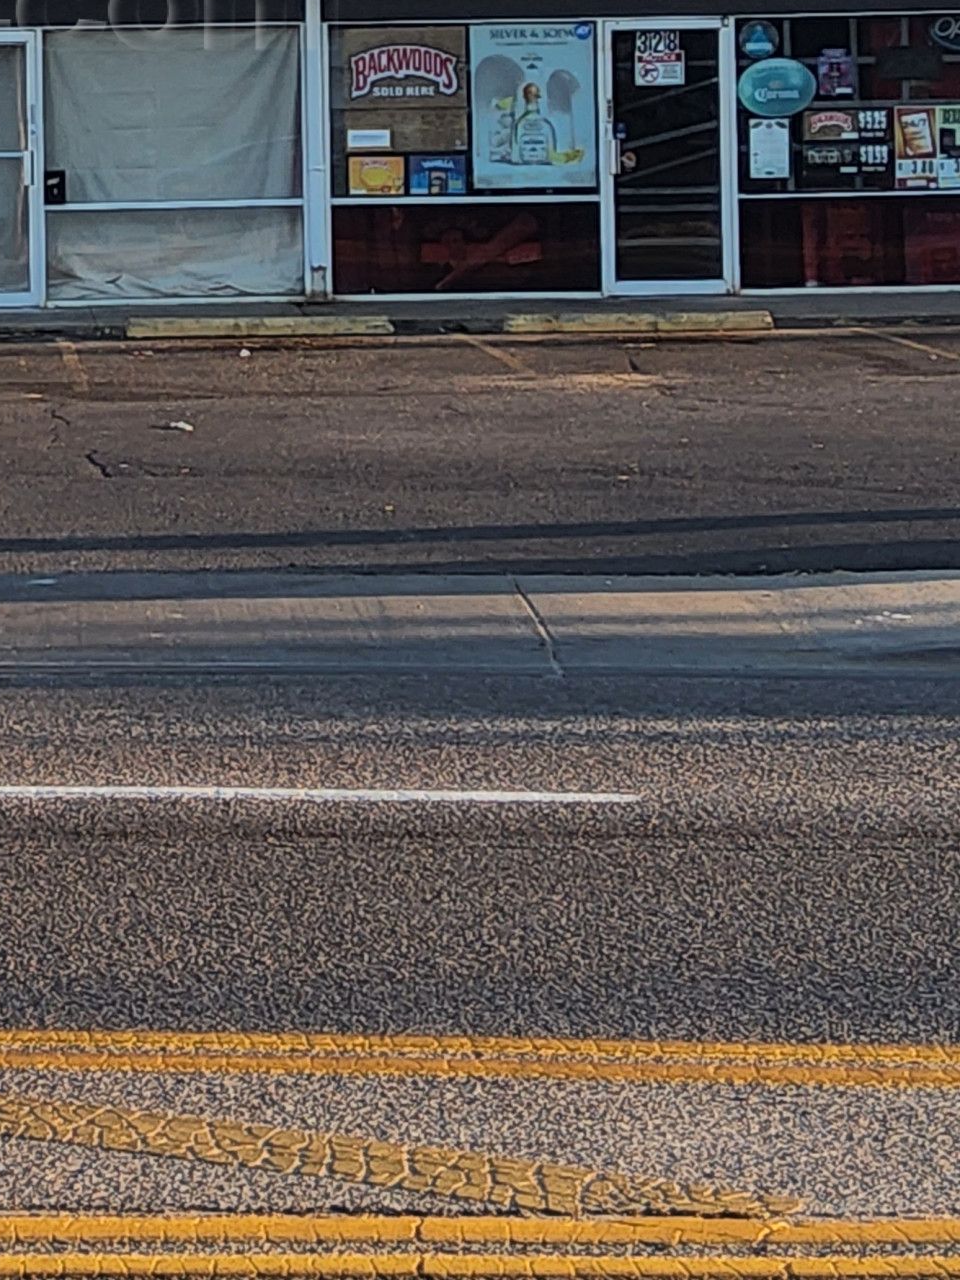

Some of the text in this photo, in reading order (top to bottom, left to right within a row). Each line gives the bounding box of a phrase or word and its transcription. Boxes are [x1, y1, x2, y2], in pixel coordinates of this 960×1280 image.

[489, 28, 528, 39] SILVER
[638, 31, 677, 54] 328
[353, 48, 455, 92] BACKWOODS
[373, 86, 435, 97] SOLD HERE
